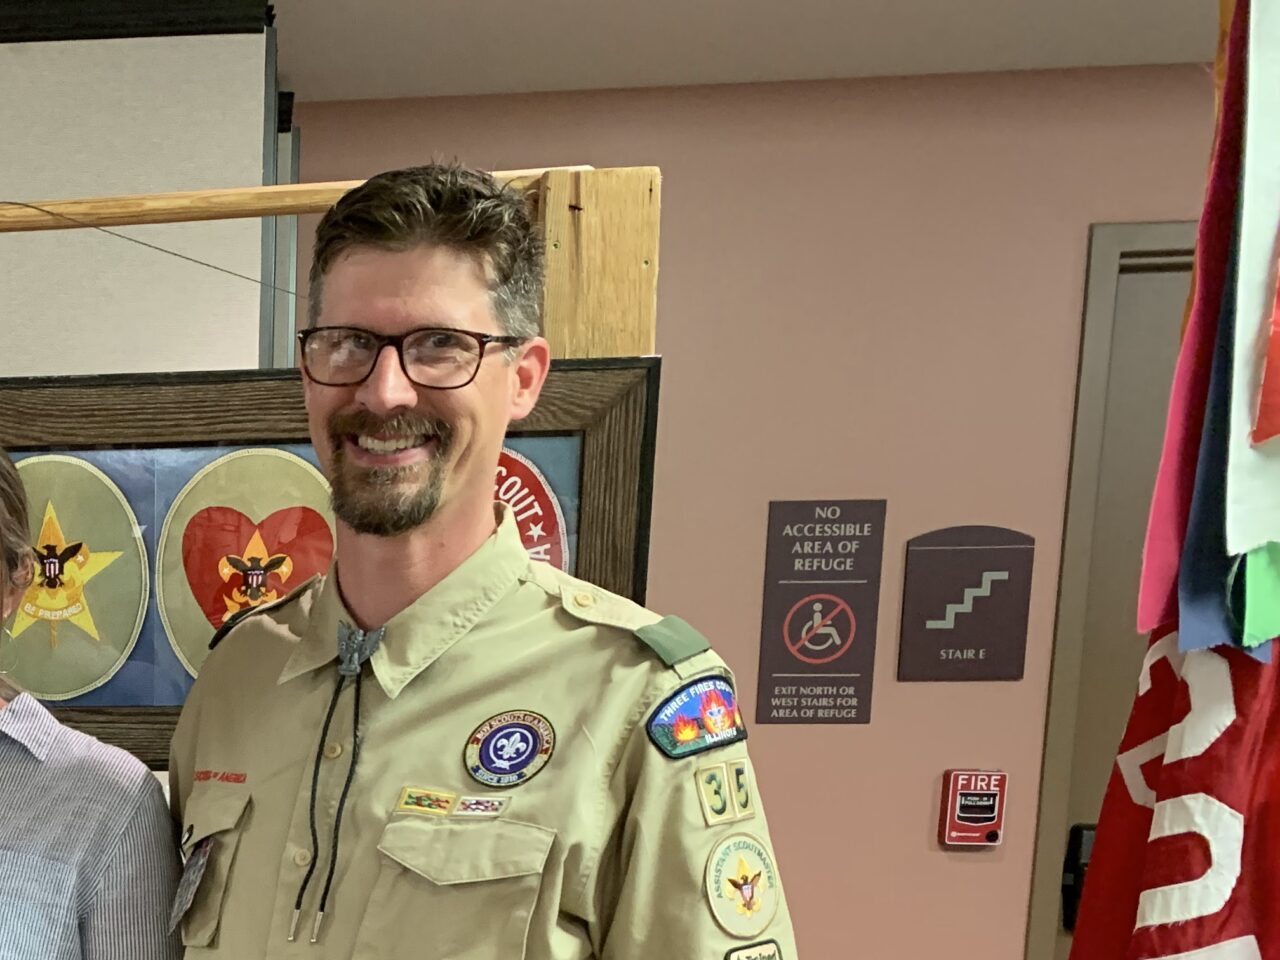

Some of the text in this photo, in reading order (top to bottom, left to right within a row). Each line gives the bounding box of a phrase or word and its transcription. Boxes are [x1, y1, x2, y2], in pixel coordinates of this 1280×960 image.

[815, 506, 841, 519] NO
[782, 523, 872, 536] ACCESSIBLE
[791, 541, 860, 554] AREA OF
[794, 558, 855, 571] REFUGE
[939, 649, 987, 660] STAIR E
[774, 686, 856, 695] EXIT NORTH OR
[660, 694, 690, 722] THREE
[689, 681, 715, 698] FIRES
[771, 698, 858, 706] WEST STAIRS FOR
[770, 709, 857, 718] AREA OF REFUGE
[704, 727, 737, 744] ILLINOIS
[958, 775, 1001, 791] FIRE
[705, 767, 749, 816] 35
[713, 840, 774, 899] ASSISTANT SCOUTMASTER
